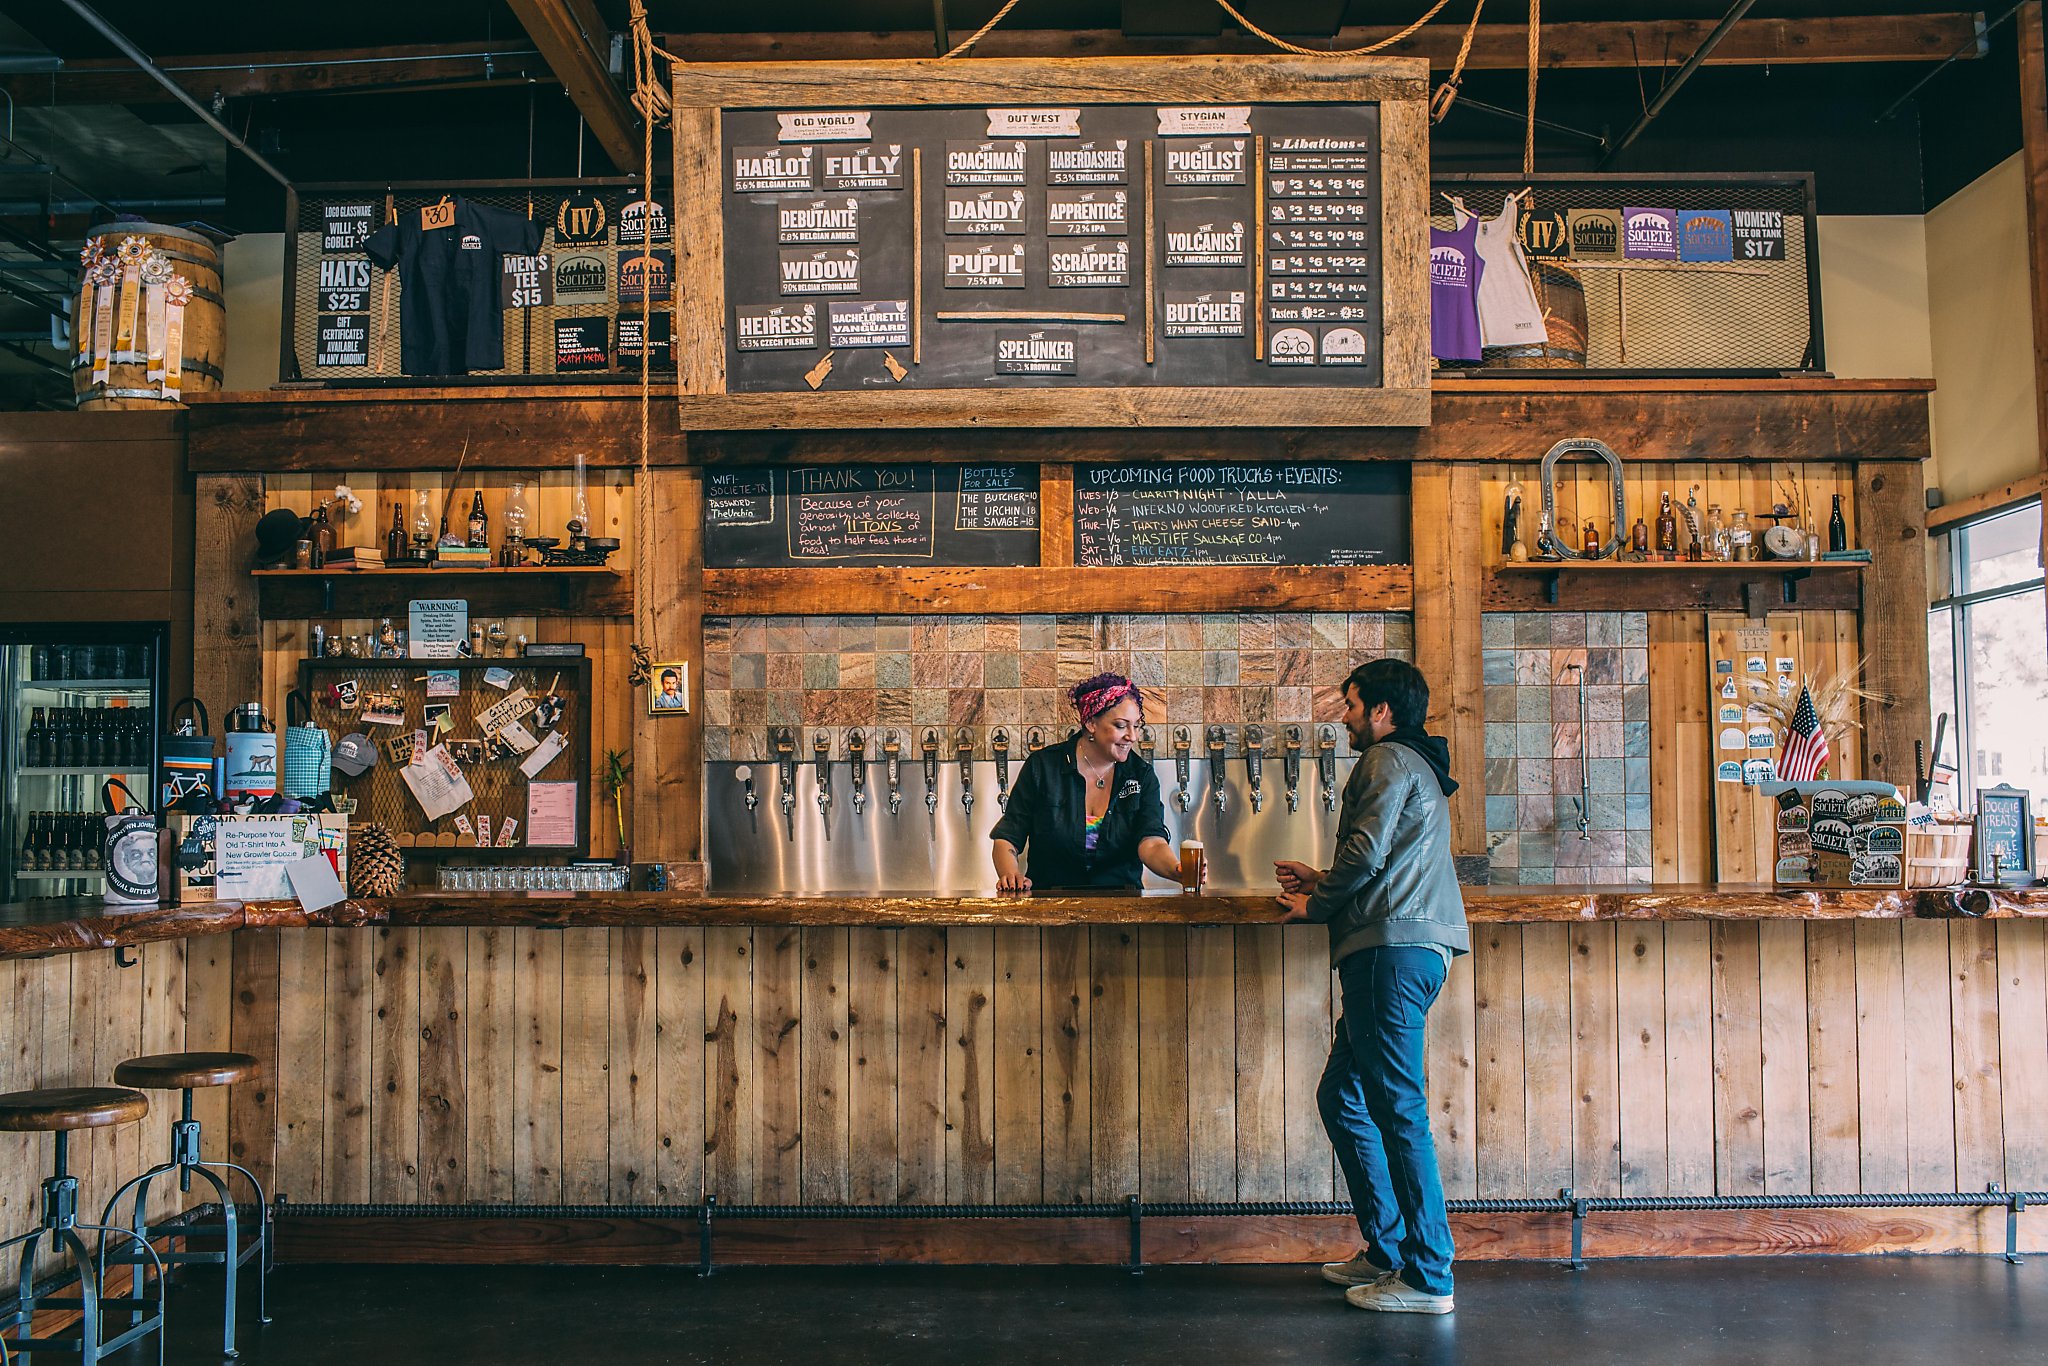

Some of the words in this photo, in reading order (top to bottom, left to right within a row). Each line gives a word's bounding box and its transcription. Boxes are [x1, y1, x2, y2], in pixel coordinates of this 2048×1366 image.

[794, 117, 814, 126] OLD
[818, 117, 854, 125] WORLD
[1031, 114, 1060, 122] WEST
[1180, 112, 1225, 120] STYGIAN
[1282, 139, 1356, 149] Libations
[826, 156, 899, 175] FILLY
[949, 152, 1023, 170] COACHMAN
[1050, 151, 1125, 169] HABERDASHER
[1168, 152, 1243, 170] PUGILIST
[736, 158, 810, 177] HARLOT
[1076, 173, 1106, 181] ENGLISH
[1108, 173, 1119, 181] IPA
[757, 180, 786, 188] BELGIAN
[788, 180, 810, 188] EXTRA
[1289, 179, 1303, 189] $3
[1309, 179, 1323, 189] $4
[1328, 179, 1343, 189] $8
[1346, 179, 1364, 189] $16
[325, 207, 339, 217] LOGO
[340, 206, 371, 217] GLASSWARE
[425, 206, 448, 224] $30
[949, 200, 1022, 219] DANDY
[1050, 203, 1124, 220] APPRENTICE
[1309, 205, 1322, 215] $5
[571, 208, 593, 235] IV
[781, 209, 856, 228] DEBUTANTE
[1734, 211, 1781, 228] WOMEN'S
[330, 222, 351, 234] WILLI
[357, 221, 367, 235] $5
[990, 223, 1004, 231] IPA
[1092, 224, 1105, 232] IPA
[1735, 228, 1749, 238] TEE
[1750, 228, 1761, 237] OR
[1762, 229, 1782, 238] TANK
[1531, 221, 1554, 248] IV
[1574, 233, 1616, 245] SOCIETE
[1628, 229, 1672, 243] SOCIETE
[325, 236, 355, 249] GOBLET
[1168, 233, 1242, 251] VOLCANIST
[1745, 239, 1774, 257] $17
[504, 255, 548, 273] MEN'S
[949, 254, 1022, 273] PUPIL
[1052, 253, 1126, 272] SCRAPPER
[320, 261, 370, 287] HATS
[782, 261, 857, 279] WIDOW
[514, 272, 538, 288] TEE
[557, 273, 605, 287] SOCIETE
[989, 277, 1003, 285] IPA
[821, 283, 842, 291] STRONG
[1348, 284, 1366, 292] N/A
[328, 292, 360, 311] $25
[512, 288, 542, 307] $15
[832, 313, 906, 323] BACHELORETTE
[1166, 304, 1241, 321] BUTCHER
[1271, 308, 1298, 319] Tasters
[337, 317, 351, 327] GIFT
[740, 316, 813, 335] HEIRESS
[833, 324, 906, 332] VANGUARD
[323, 329, 363, 340] CERTIFICATES
[1185, 326, 1218, 334] IMPERIAL
[785, 338, 813, 346] PILSNER
[886, 335, 906, 343] LAGER
[327, 341, 358, 352] AVAILABLE
[999, 340, 1073, 360] SPELUNKER
[319, 354, 325, 365] IN
[326, 354, 339, 365] ANY
[340, 353, 365, 365] AMOUNT
[1051, 363, 1061, 371] ALE
[964, 468, 1015, 479] BOTTLES
[1090, 468, 1172, 484] UPCOMING
[1178, 467, 1215, 483] FOOD
[1219, 467, 1273, 483] TRUCKS
[793, 468, 862, 492] THANK
[874, 469, 915, 488] YOU!
[986, 479, 1009, 487] SALE
[961, 494, 978, 503] THE
[1132, 490, 1179, 499] CHARITY
[1183, 488, 1225, 501] NIGHT
[1235, 486, 1286, 501] YALLA
[800, 497, 853, 510] Because
[857, 496, 871, 508] of
[876, 499, 905, 510] your
[853, 512, 873, 520] we
[877, 510, 920, 520] collected
[961, 507, 978, 516] THE
[985, 506, 1020, 516] URCHIN
[1132, 503, 1184, 517] INFERNO
[1189, 503, 1253, 514] WOODFIRED
[801, 523, 837, 532] almost
[860, 520, 902, 532] TONS
[908, 521, 920, 530] of
[984, 517, 1018, 527] SAVAGE
[1171, 519, 1199, 530] WHAT
[1202, 518, 1246, 529] CHEESE
[799, 534, 822, 546] food
[829, 536, 840, 545] to
[844, 534, 866, 545] help
[869, 536, 890, 545] feed
[893, 535, 917, 544] those
[1132, 533, 1189, 545] MASTIFF
[1193, 532, 1246, 546] SAUSAGE
[802, 545, 830, 555] need!
[489, 698, 513, 718] GIFT
[1985, 800, 2020, 814] DOGGIE
[1985, 815, 2018, 828] TREATS
[226, 831, 267, 839] Re-Purpose
